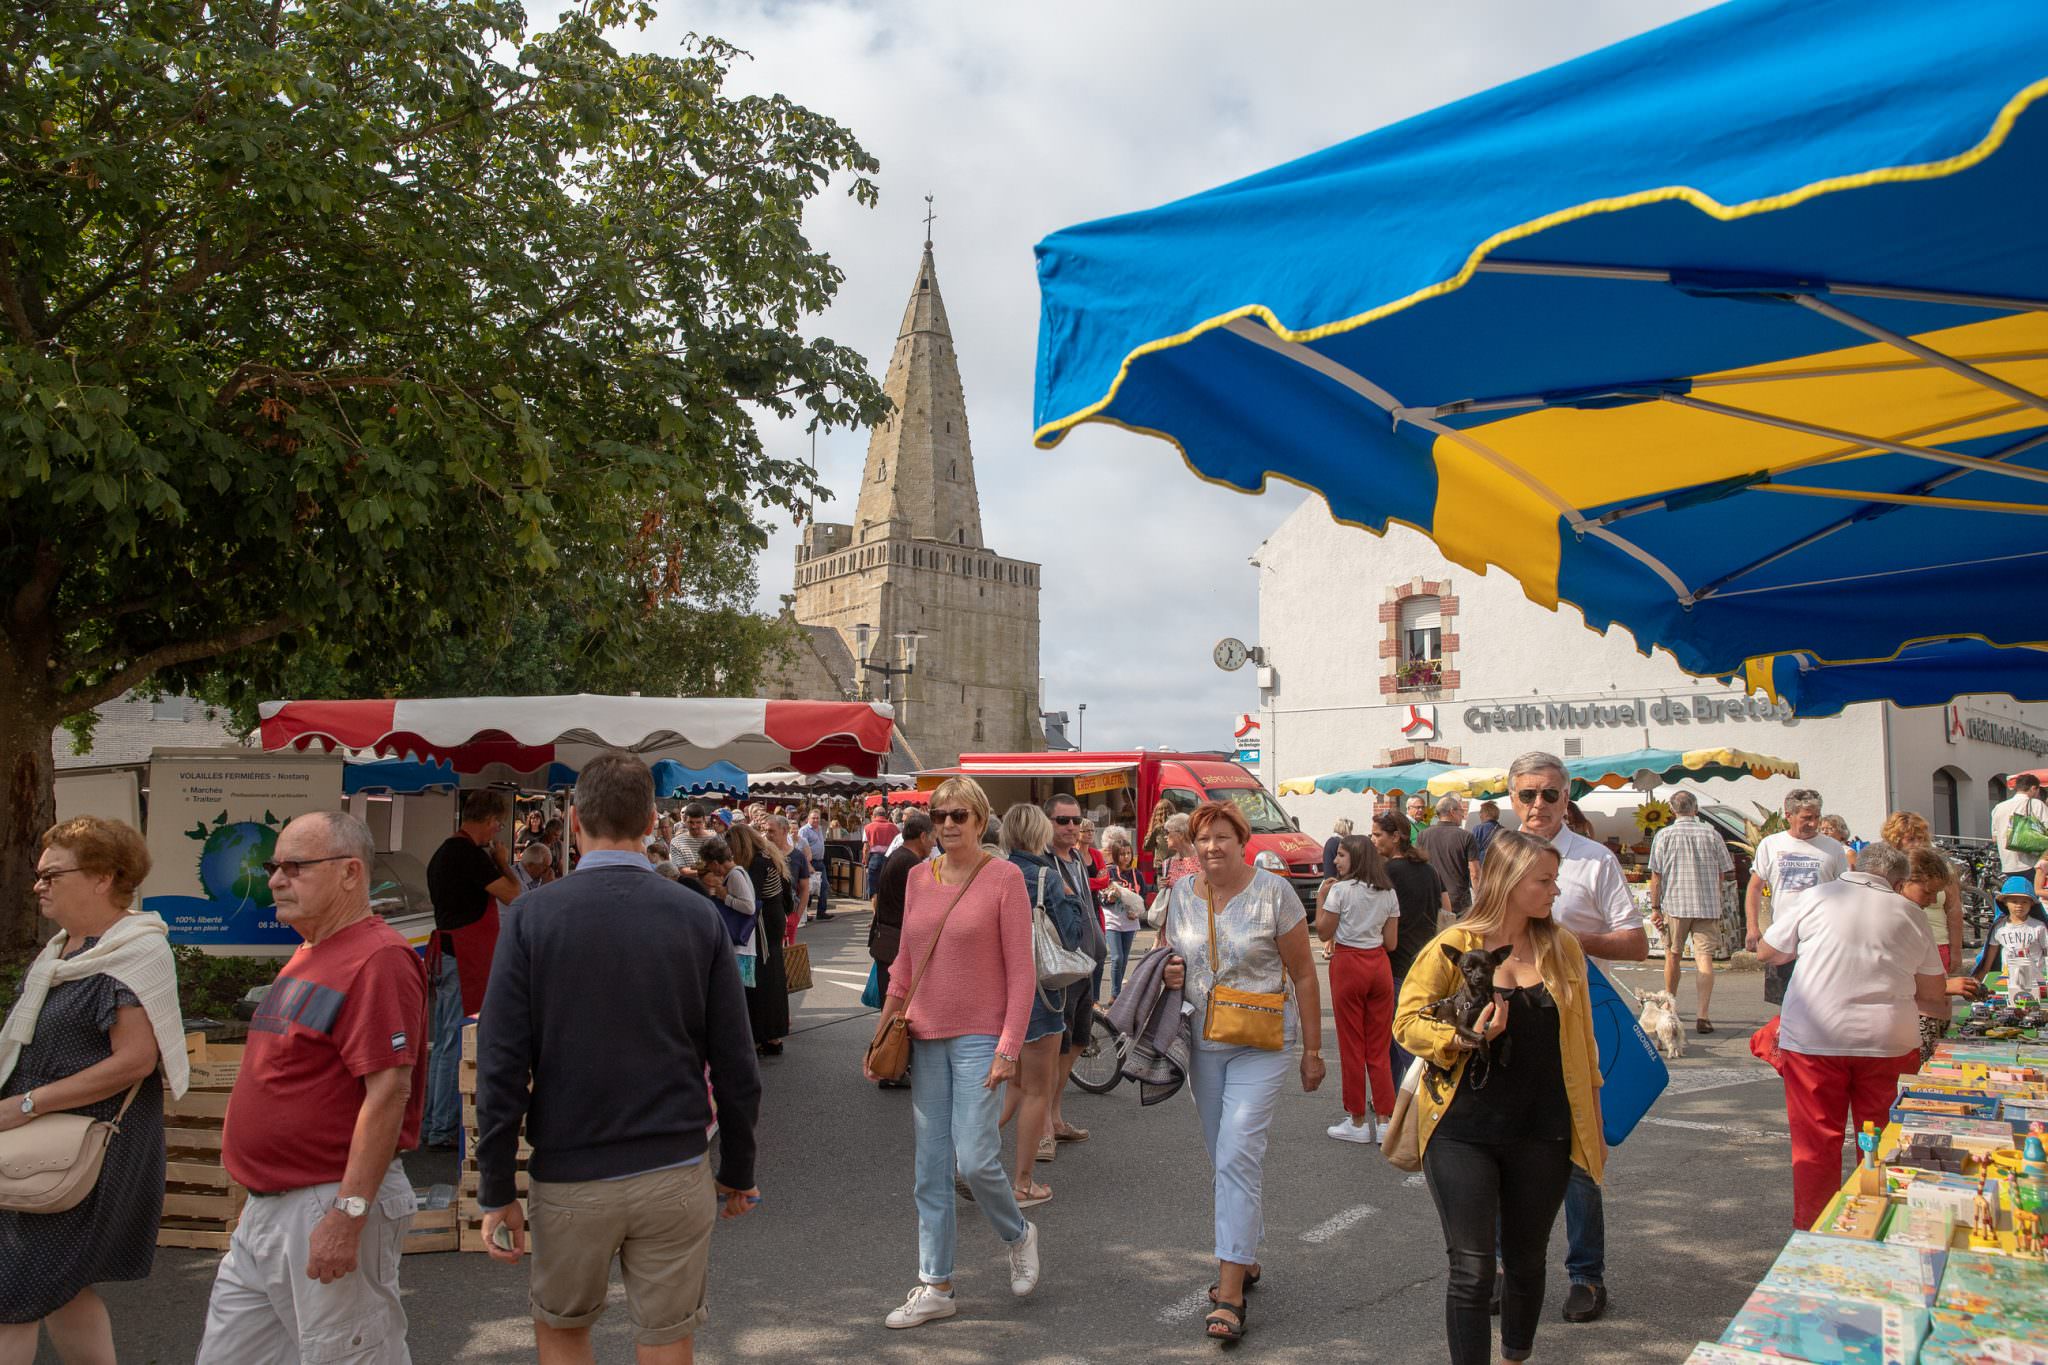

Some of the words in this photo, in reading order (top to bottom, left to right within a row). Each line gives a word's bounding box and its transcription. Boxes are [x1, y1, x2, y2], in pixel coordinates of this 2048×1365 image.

[1464, 704, 1545, 733] Crédit
[1545, 697, 1647, 730] Mutuel
[1650, 697, 1691, 726] de
[180, 771, 223, 780] VOLAILLES
[278, 772, 310, 781] Nostang
[190, 786, 223, 794] Marchés
[175, 916, 195, 924] 100%
